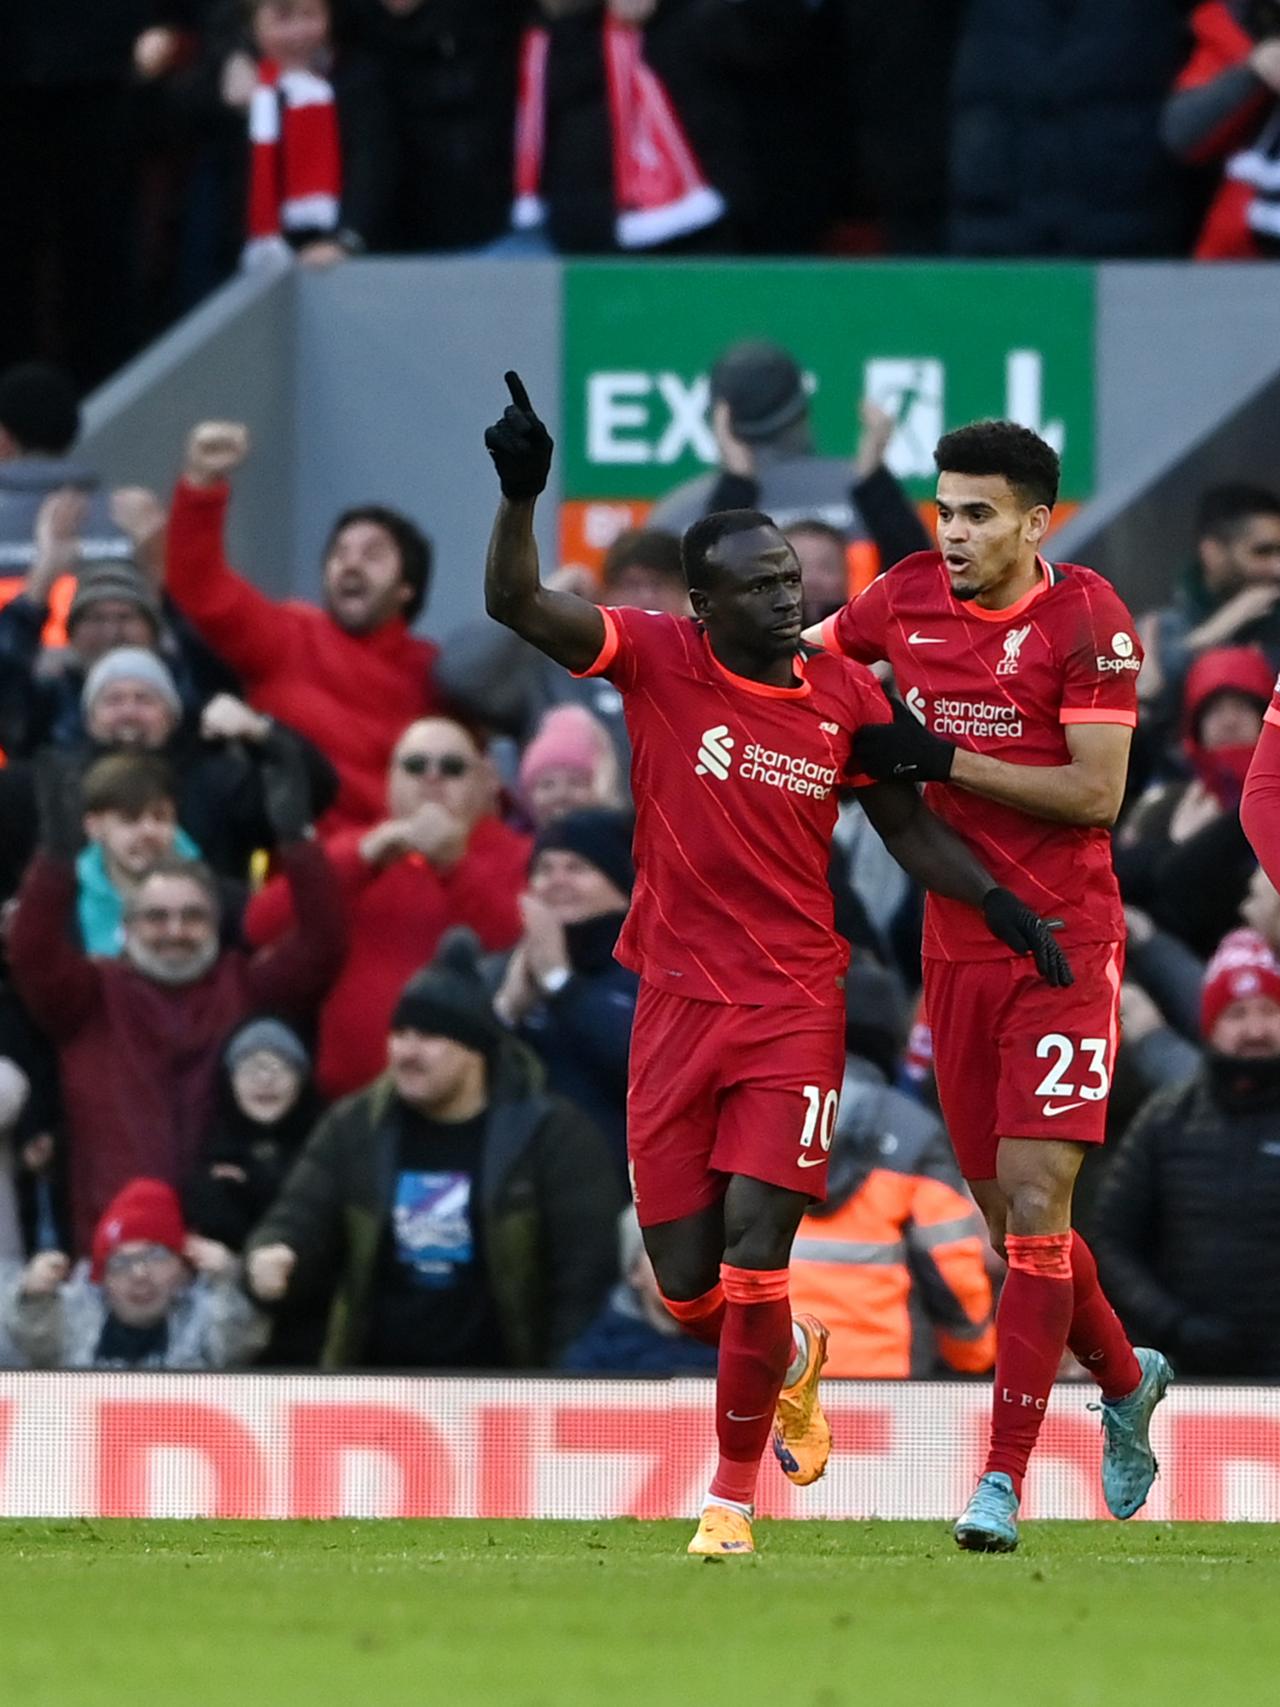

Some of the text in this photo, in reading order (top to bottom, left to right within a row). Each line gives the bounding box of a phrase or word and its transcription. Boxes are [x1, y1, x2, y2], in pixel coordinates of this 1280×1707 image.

[933, 698, 1016, 721] standard
[933, 716, 1023, 738] chartered
[742, 743, 838, 785] standard
[1034, 1033, 1109, 1101] 23
[800, 1085, 838, 1152] 10
